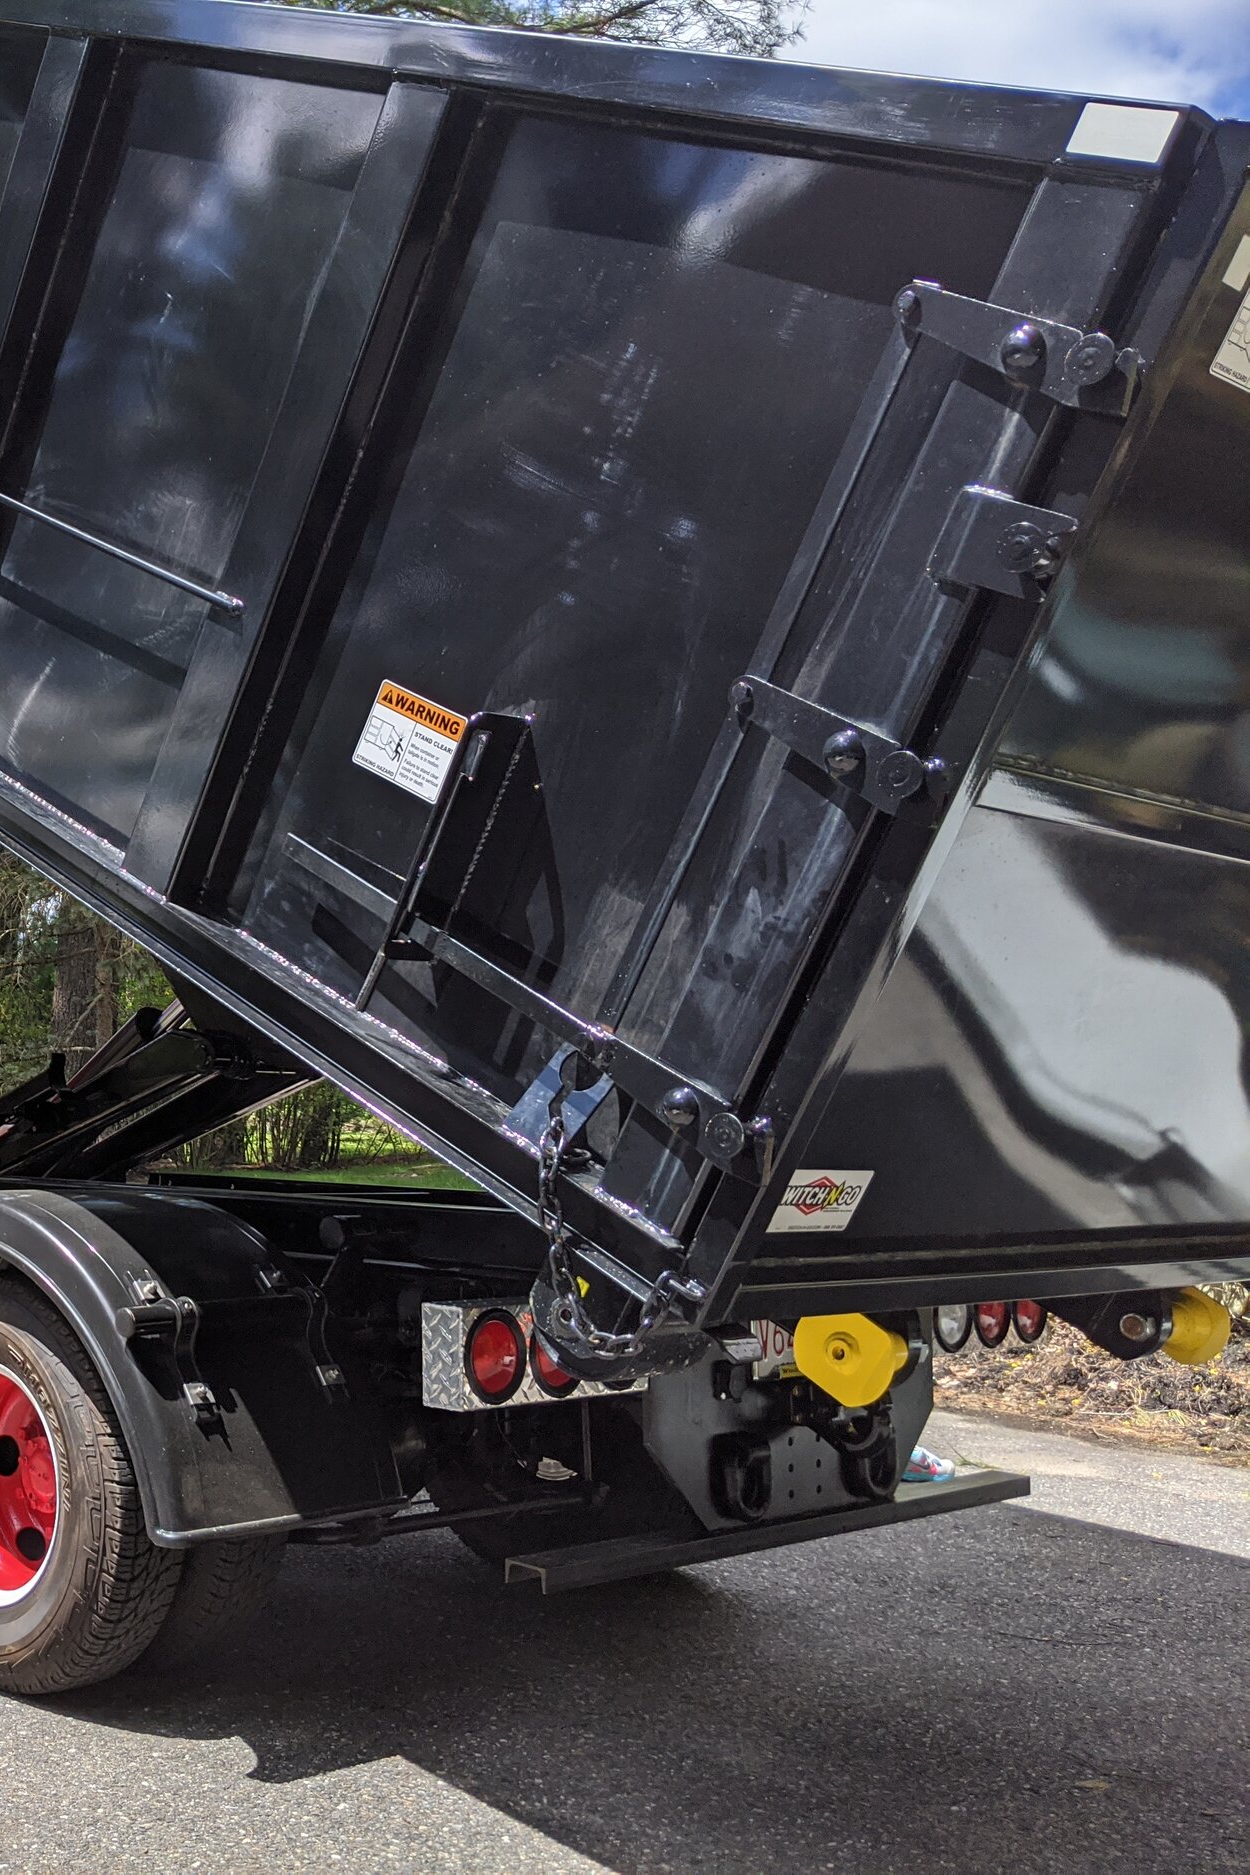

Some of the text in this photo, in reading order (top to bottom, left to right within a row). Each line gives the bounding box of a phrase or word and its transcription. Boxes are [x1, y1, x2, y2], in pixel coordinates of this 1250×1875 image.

[394, 693, 460, 736] WARNING
[414, 731, 454, 755] STAND CLEAR!
[356, 753, 394, 776] STRIKING HAZARD
[837, 1185, 863, 1206] GO
